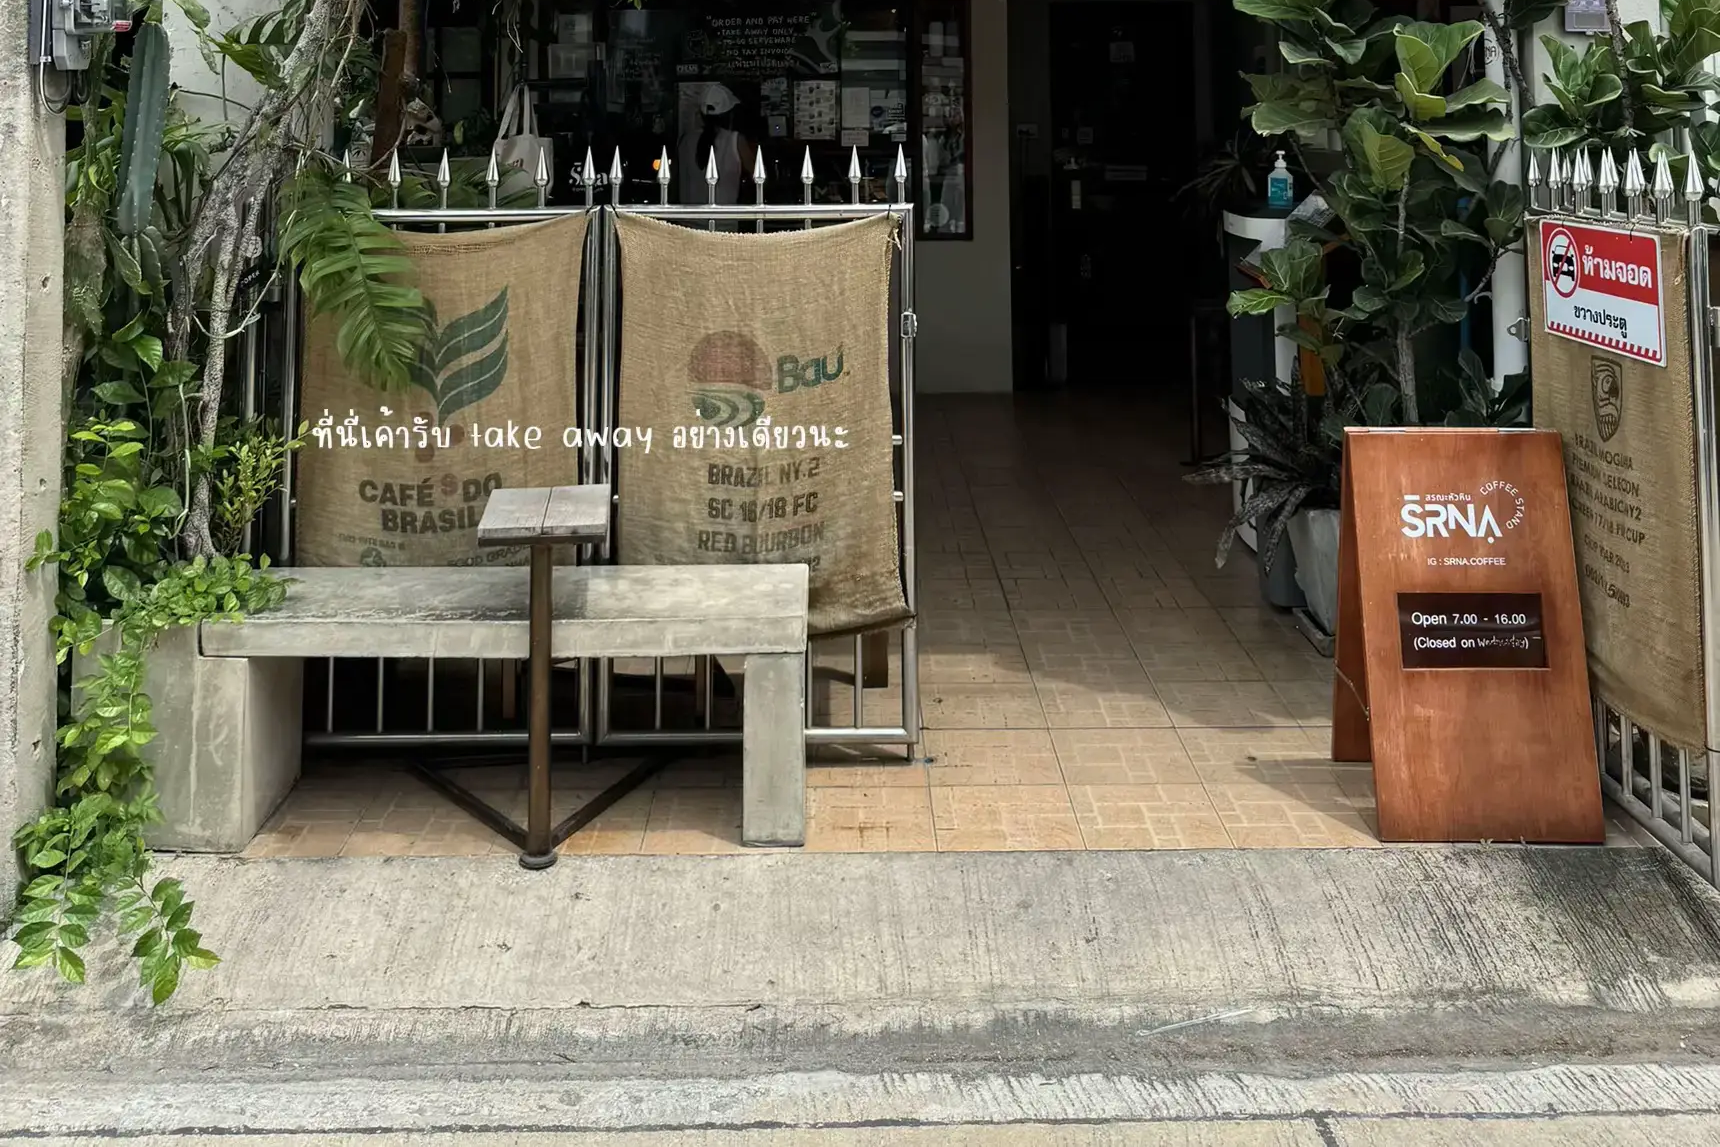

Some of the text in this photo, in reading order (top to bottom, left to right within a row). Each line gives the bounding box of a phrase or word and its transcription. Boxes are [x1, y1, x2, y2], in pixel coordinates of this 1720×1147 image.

[745, 16, 764, 26] AND
[767, 15, 784, 25] PAY
[744, 28, 769, 36] AWAY
[772, 27, 795, 36] ONLY
[741, 48, 758, 56] TAX
[1581, 245, 1653, 289] ห้ามจอด
[1573, 305, 1628, 339] ขวางประตู
[463, 471, 503, 503] DO
[1425, 492, 1472, 502] สรณะหัวหิน
[707, 497, 734, 520] SC
[792, 491, 819, 517] FC
[1479, 480, 1525, 529] COFFEE STAND
[381, 505, 482, 535] BRASIL
[697, 529, 738, 553] RED
[1427, 558, 1437, 566] IG
[1443, 557, 1507, 566] SRNA.COFFEE
[1411, 611, 1448, 628] Open
[1452, 613, 1478, 625] 7.00
[1494, 613, 1527, 625] 16.00
[1413, 636, 1457, 651] (Closed
[1460, 638, 1476, 648] on
